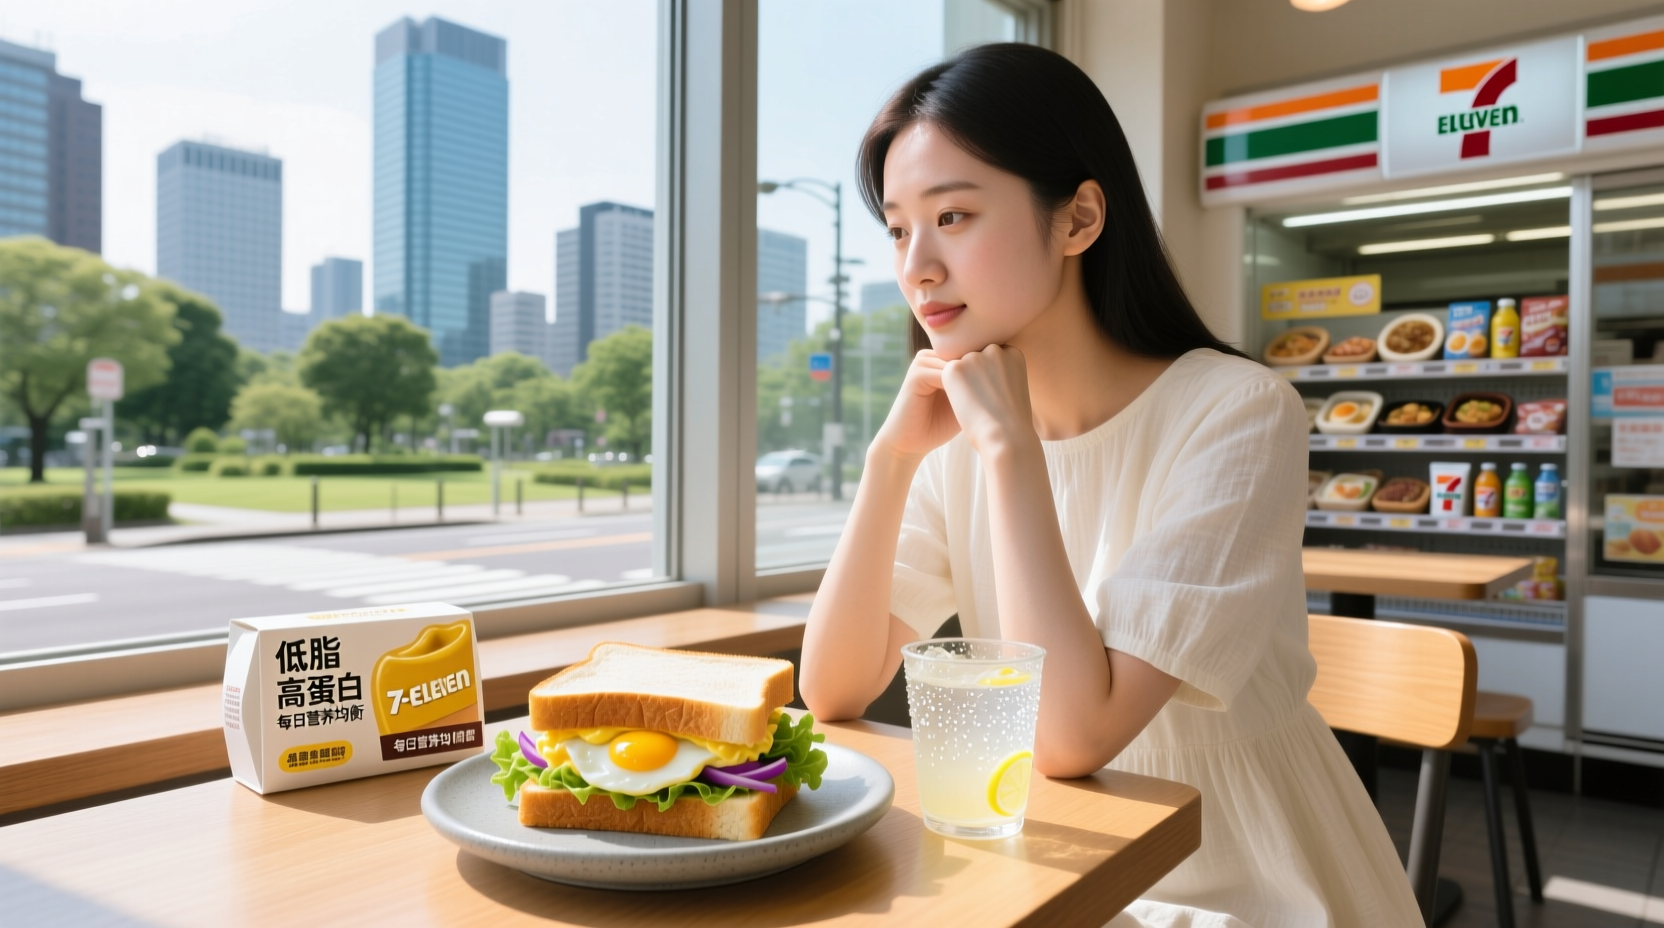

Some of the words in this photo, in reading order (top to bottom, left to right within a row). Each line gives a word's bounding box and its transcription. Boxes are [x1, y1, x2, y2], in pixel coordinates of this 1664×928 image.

[1440, 58, 1517, 159] 7
[275, 636, 341, 674] 低脂
[277, 672, 363, 710] 高蛋白
[277, 704, 365, 730] 每日营养均衡
